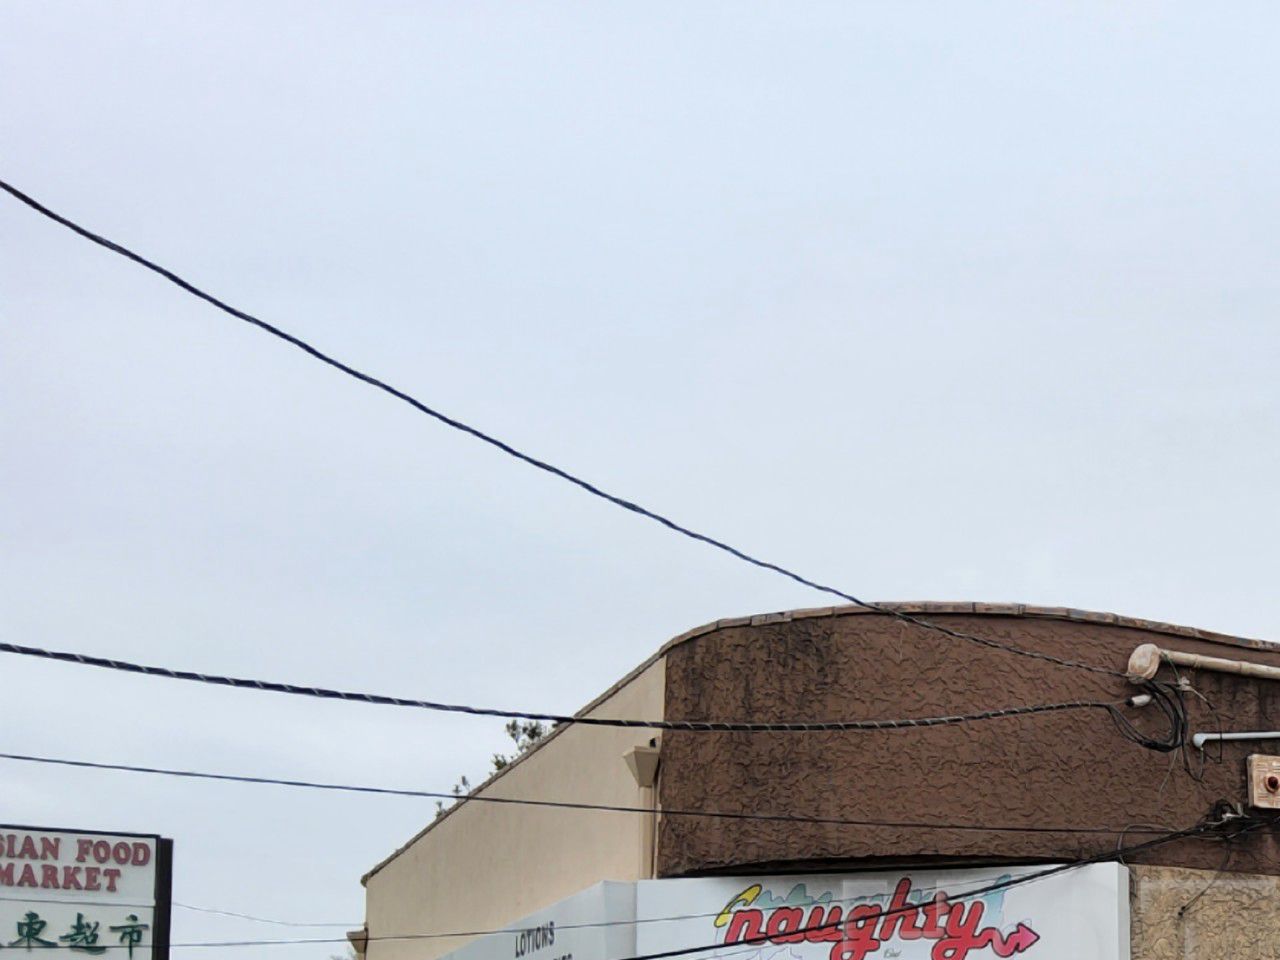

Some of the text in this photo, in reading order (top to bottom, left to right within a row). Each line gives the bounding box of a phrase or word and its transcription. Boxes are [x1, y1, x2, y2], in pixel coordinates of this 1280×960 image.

[76, 838, 150, 866] FOOD
[0, 863, 121, 892] MARKET
[515, 920, 555, 958] LOTIONS
